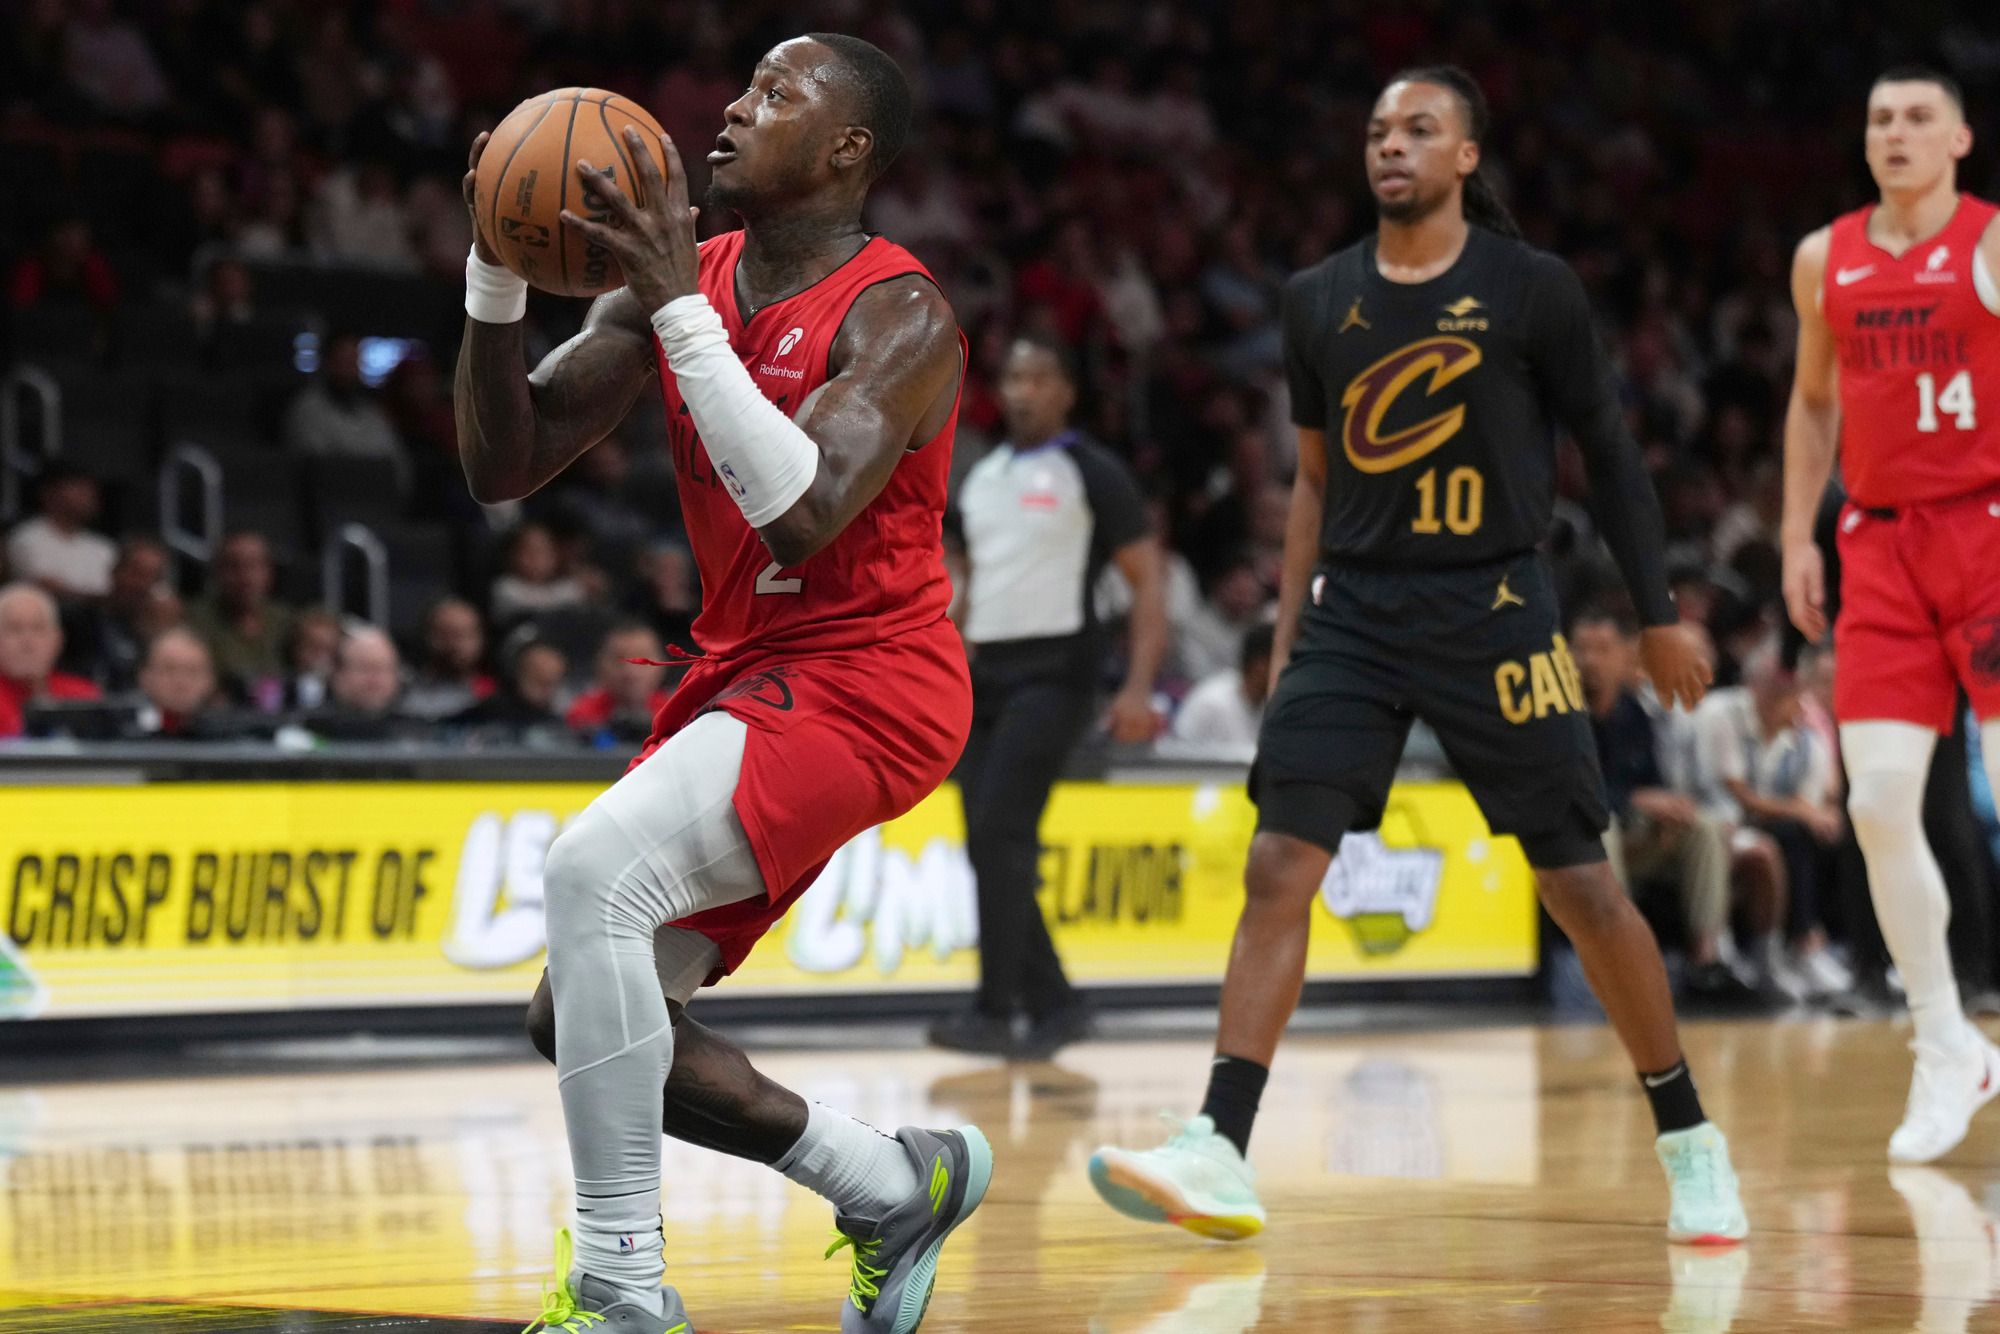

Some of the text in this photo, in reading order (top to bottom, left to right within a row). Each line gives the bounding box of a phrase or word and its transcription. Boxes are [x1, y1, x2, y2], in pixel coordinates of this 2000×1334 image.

[1436, 317, 1489, 332] CLIFFS
[1855, 303, 1942, 328] HEAT
[759, 363, 804, 379] Robinhood
[1915, 370, 1977, 432] 14
[1340, 335, 1482, 474] C
[1411, 465, 1483, 535] 10
[8, 853, 172, 948] CRISP
[184, 849, 360, 942] BURST
[369, 848, 437, 939] OF
